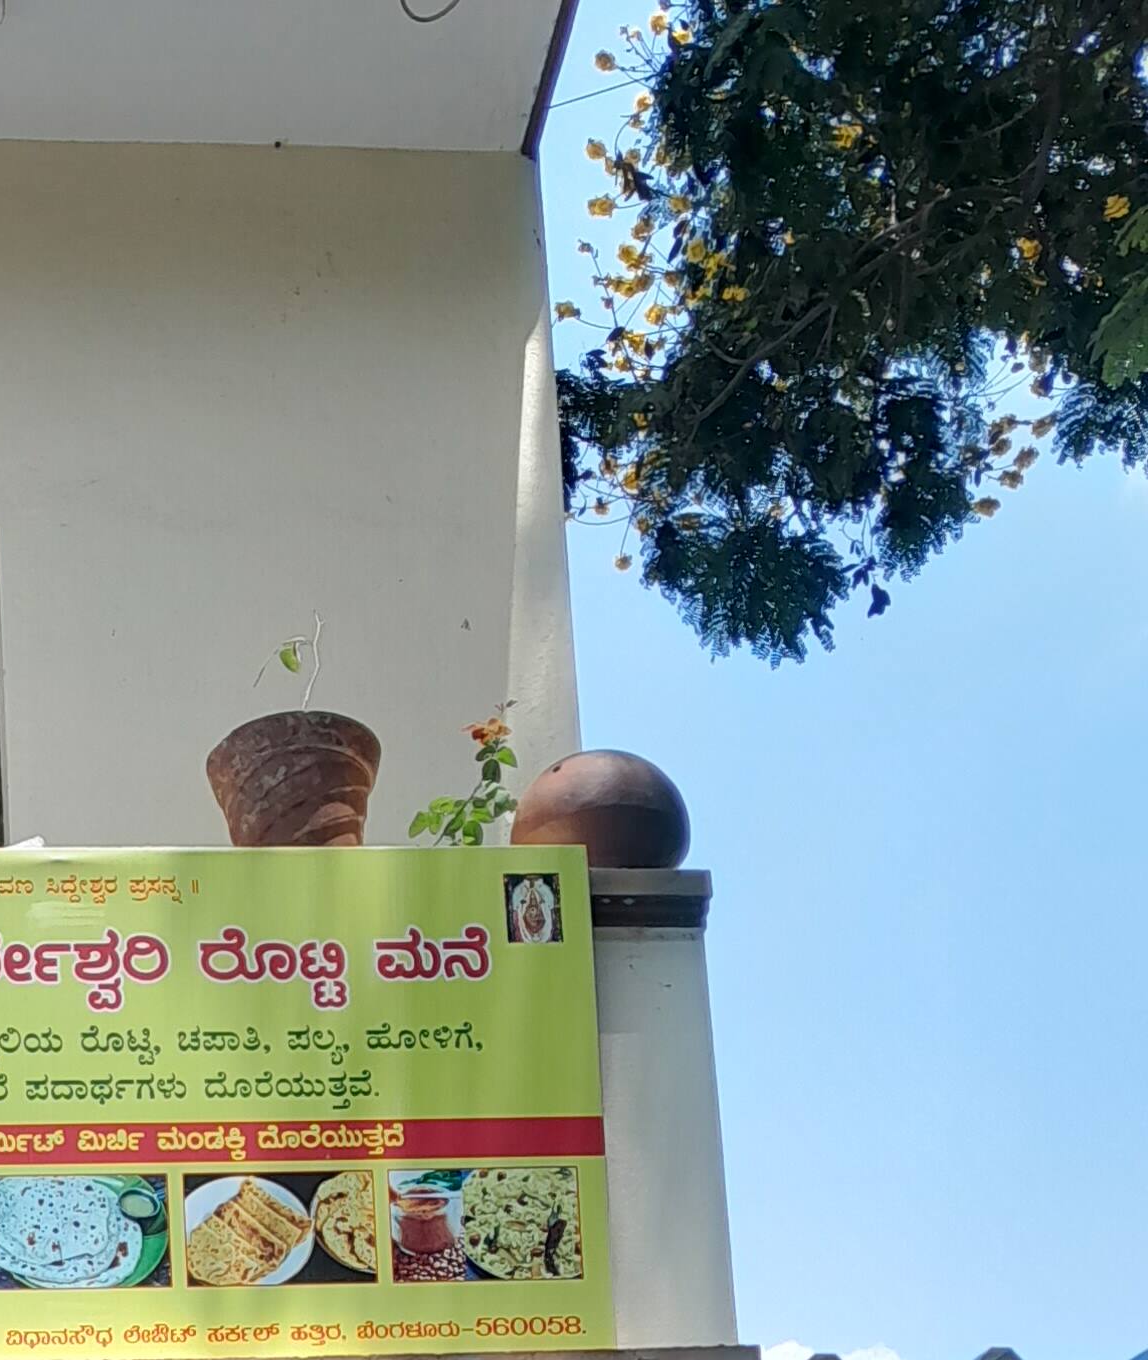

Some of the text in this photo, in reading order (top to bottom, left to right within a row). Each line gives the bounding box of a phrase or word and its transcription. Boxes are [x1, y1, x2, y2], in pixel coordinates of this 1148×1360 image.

[128, 874, 184, 904] ಪ್ರಸನ್ನ
[199, 926, 348, 1010] ರೊಟ್ಟಿ
[375, 926, 490, 981] ಮನೆ
[80, 1024, 162, 1066] ರೊಟ್ಟಿ,
[176, 1025, 272, 1055] ಚಪಾತಿ,
[286, 1024, 350, 1066] ಪಲ್ಯ,
[365, 1021, 484, 1052] ಹೋಳಿಗೆ,
[24, 1071, 187, 1106] ಪದಾರ್ಥಗಳು
[203, 1070, 380, 1111] ದೊರೆಯುತ್ತವೆ.
[77, 1128, 145, 1152] ಮಿರ್ಚಿ
[156, 1126, 247, 1161] ಮಂಡಕ್ಕಿ
[257, 1123, 405, 1155] ದೊರೆಯುತ್ತದೆ
[4, 1324, 114, 1350] ವಿಧಾನಸೌಧ
[121, 1322, 198, 1345] ಲೇಔಟ್
[206, 1323, 280, 1344] ಸರ್ಕಲ್
